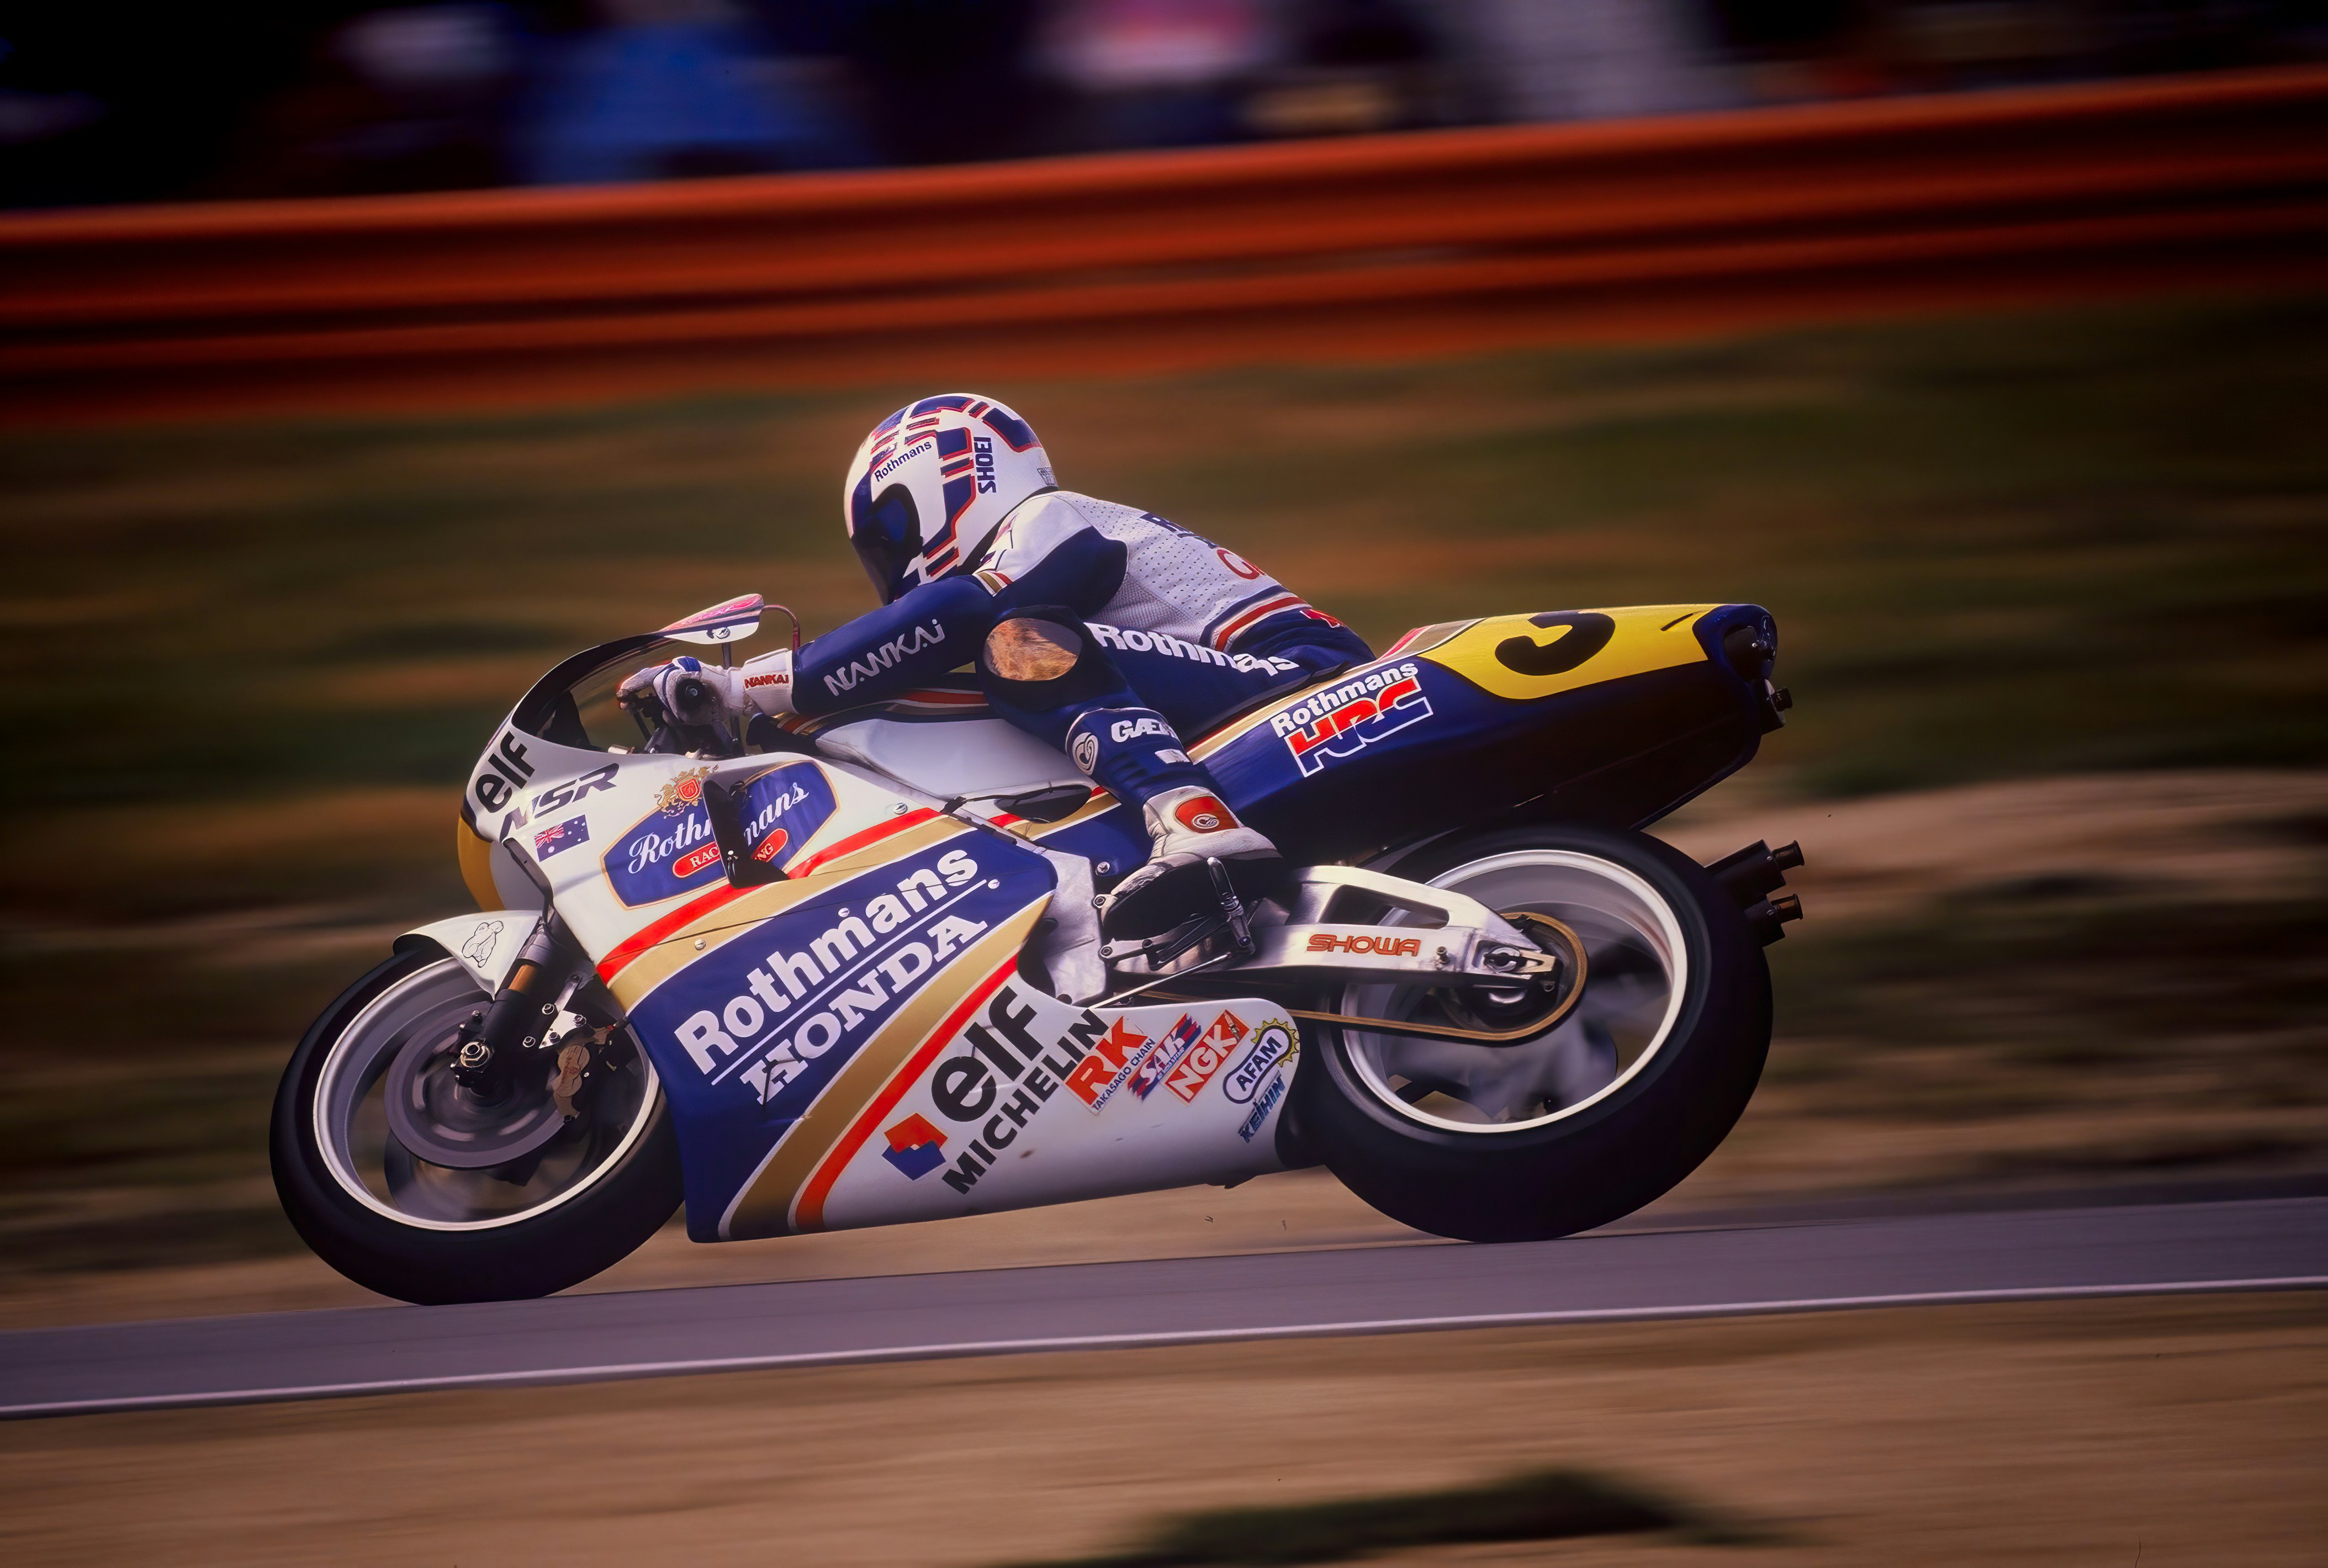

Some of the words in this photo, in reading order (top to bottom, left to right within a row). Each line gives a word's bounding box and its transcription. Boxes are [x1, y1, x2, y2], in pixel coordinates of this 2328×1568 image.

[874, 442, 932, 482] Rothmans
[973, 436, 997, 495] SHOEI
[744, 674, 789, 689] NANKAI
[1270, 661, 1419, 738] Rothmans
[1284, 674, 1434, 778] HRC
[475, 730, 536, 813] elf
[500, 762, 620, 843] NSR
[674, 849, 979, 1076] Rothmans
[1306, 933, 1422, 957] SHOWA
[739, 914, 988, 1105] HONDA
[931, 985, 1047, 1122] elf
[1065, 1015, 1149, 1106] RK
[1091, 1066, 1133, 1111] TAKASAGO
[1130, 1038, 1156, 1067] CHAIN
[1168, 1024, 1237, 1100] NGK
[1236, 1036, 1283, 1092] AFAM
[941, 1008, 1110, 1195] MICHELIN
